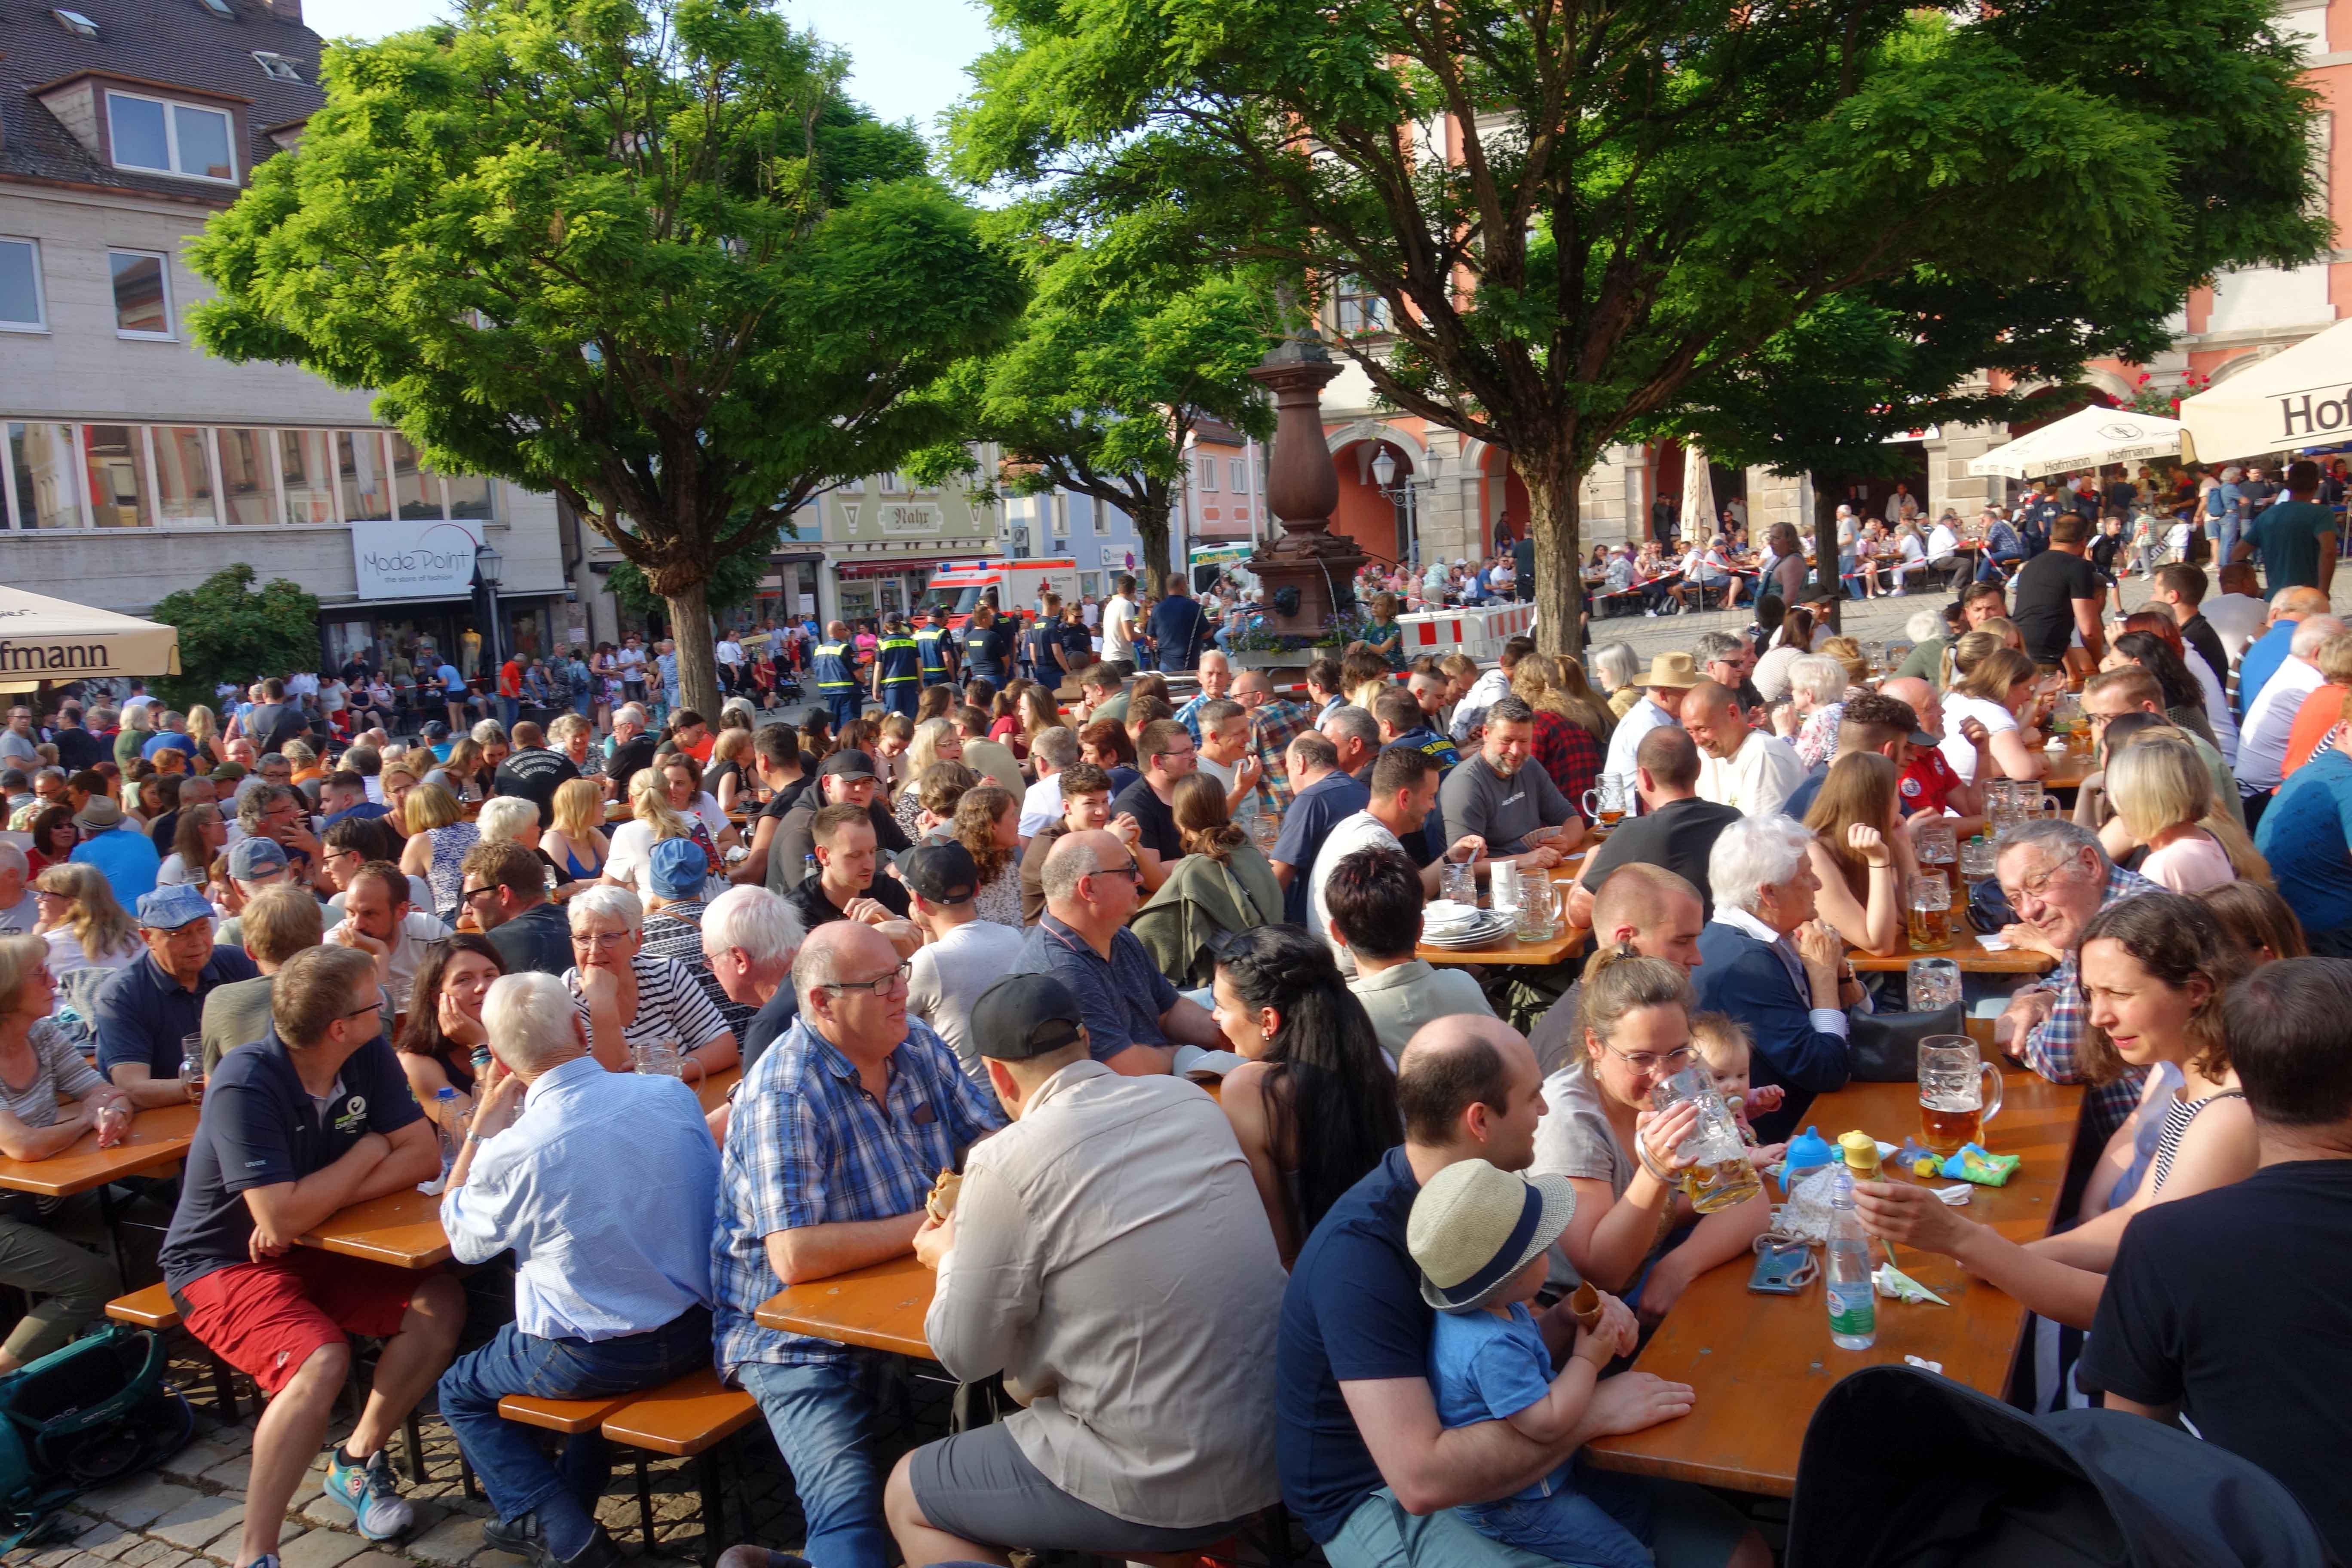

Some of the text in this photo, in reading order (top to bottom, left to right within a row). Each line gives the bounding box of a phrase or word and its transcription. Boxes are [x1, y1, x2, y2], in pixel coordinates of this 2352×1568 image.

[2044, 456, 2091, 472] Hofmann
[2107, 447, 2154, 461] Hofmann
[364, 550, 470, 576] Mode Point
